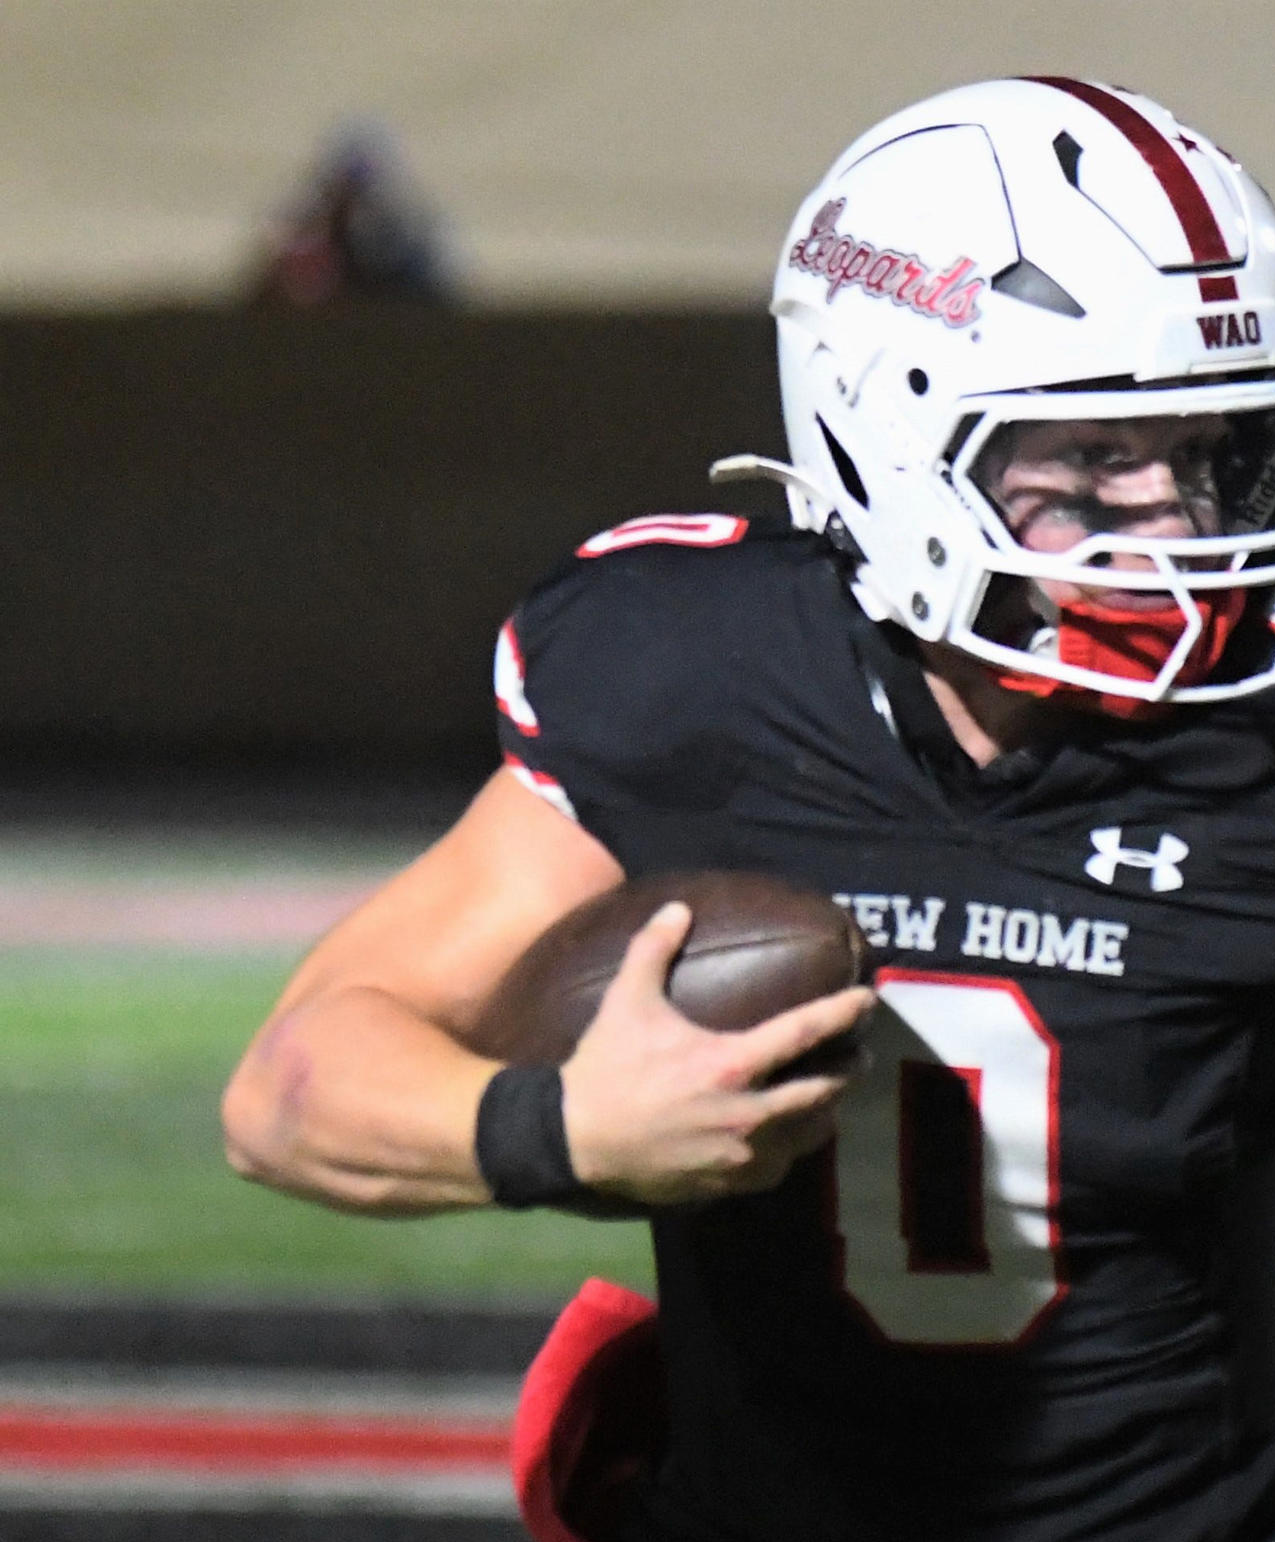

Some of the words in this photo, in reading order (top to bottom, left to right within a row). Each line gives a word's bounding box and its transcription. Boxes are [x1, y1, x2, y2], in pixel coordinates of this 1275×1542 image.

[790, 197, 985, 329] Leopards
[831, 893, 947, 952] EW
[961, 901, 1129, 977] HOME
[828, 966, 1070, 1354] 0
